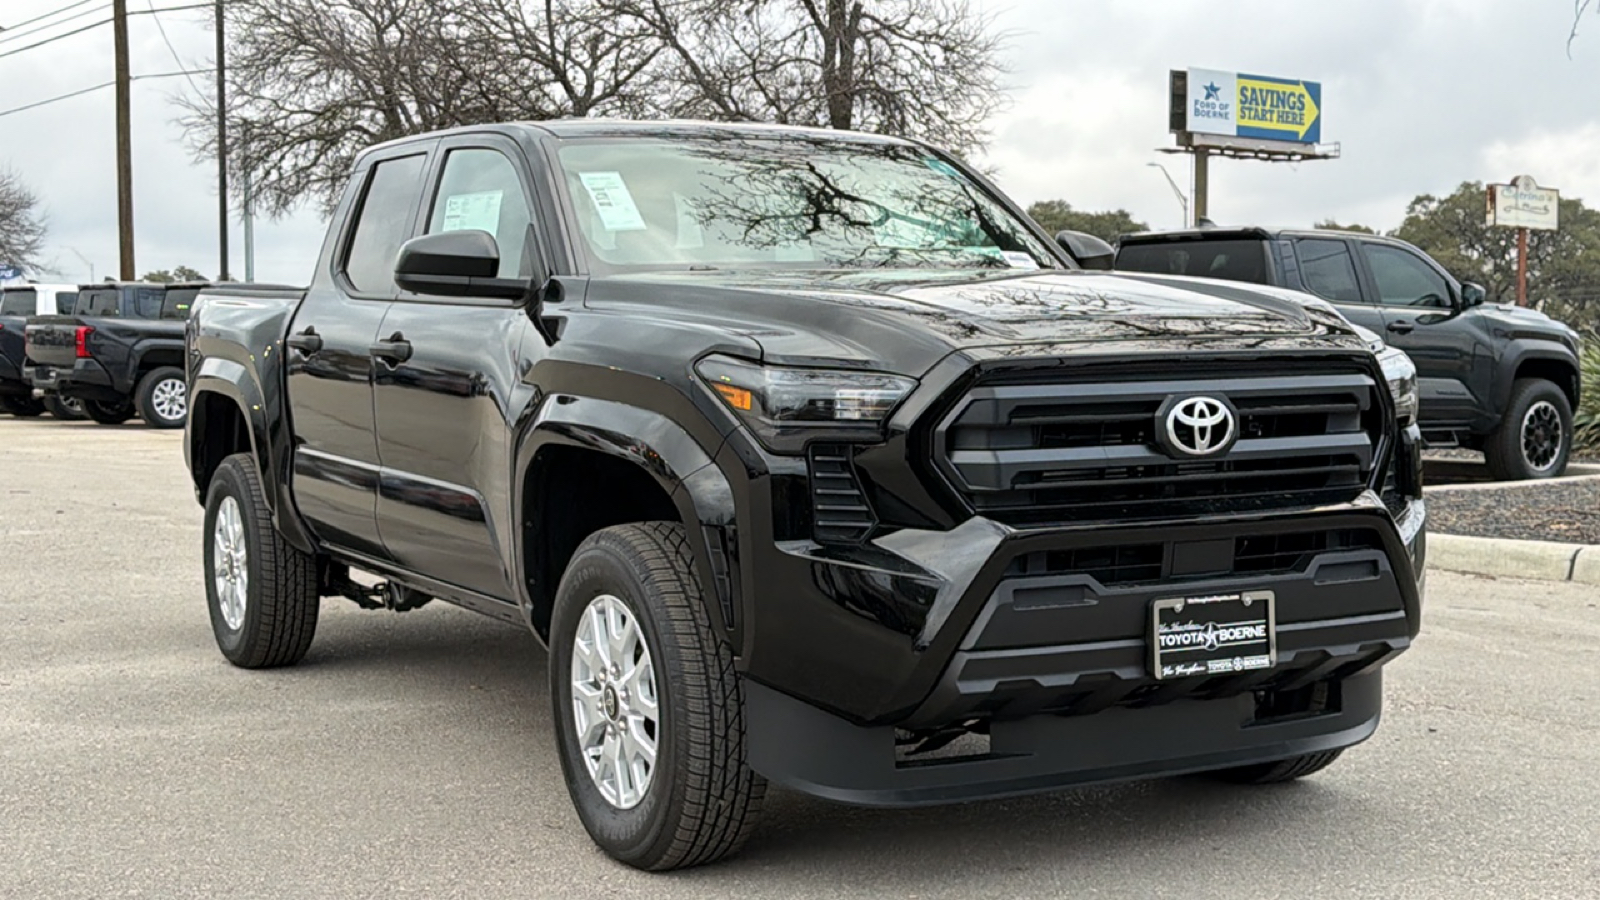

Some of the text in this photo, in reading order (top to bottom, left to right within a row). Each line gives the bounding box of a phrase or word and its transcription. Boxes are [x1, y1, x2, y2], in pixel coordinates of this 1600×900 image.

[1194, 99, 1230, 111] FORD OF
[1239, 86, 1306, 112] SAVINGS
[1194, 108, 1230, 120] BOERNE
[1239, 106, 1306, 126] START HERE
[1160, 625, 1266, 647] TOYOTA BOERNE
